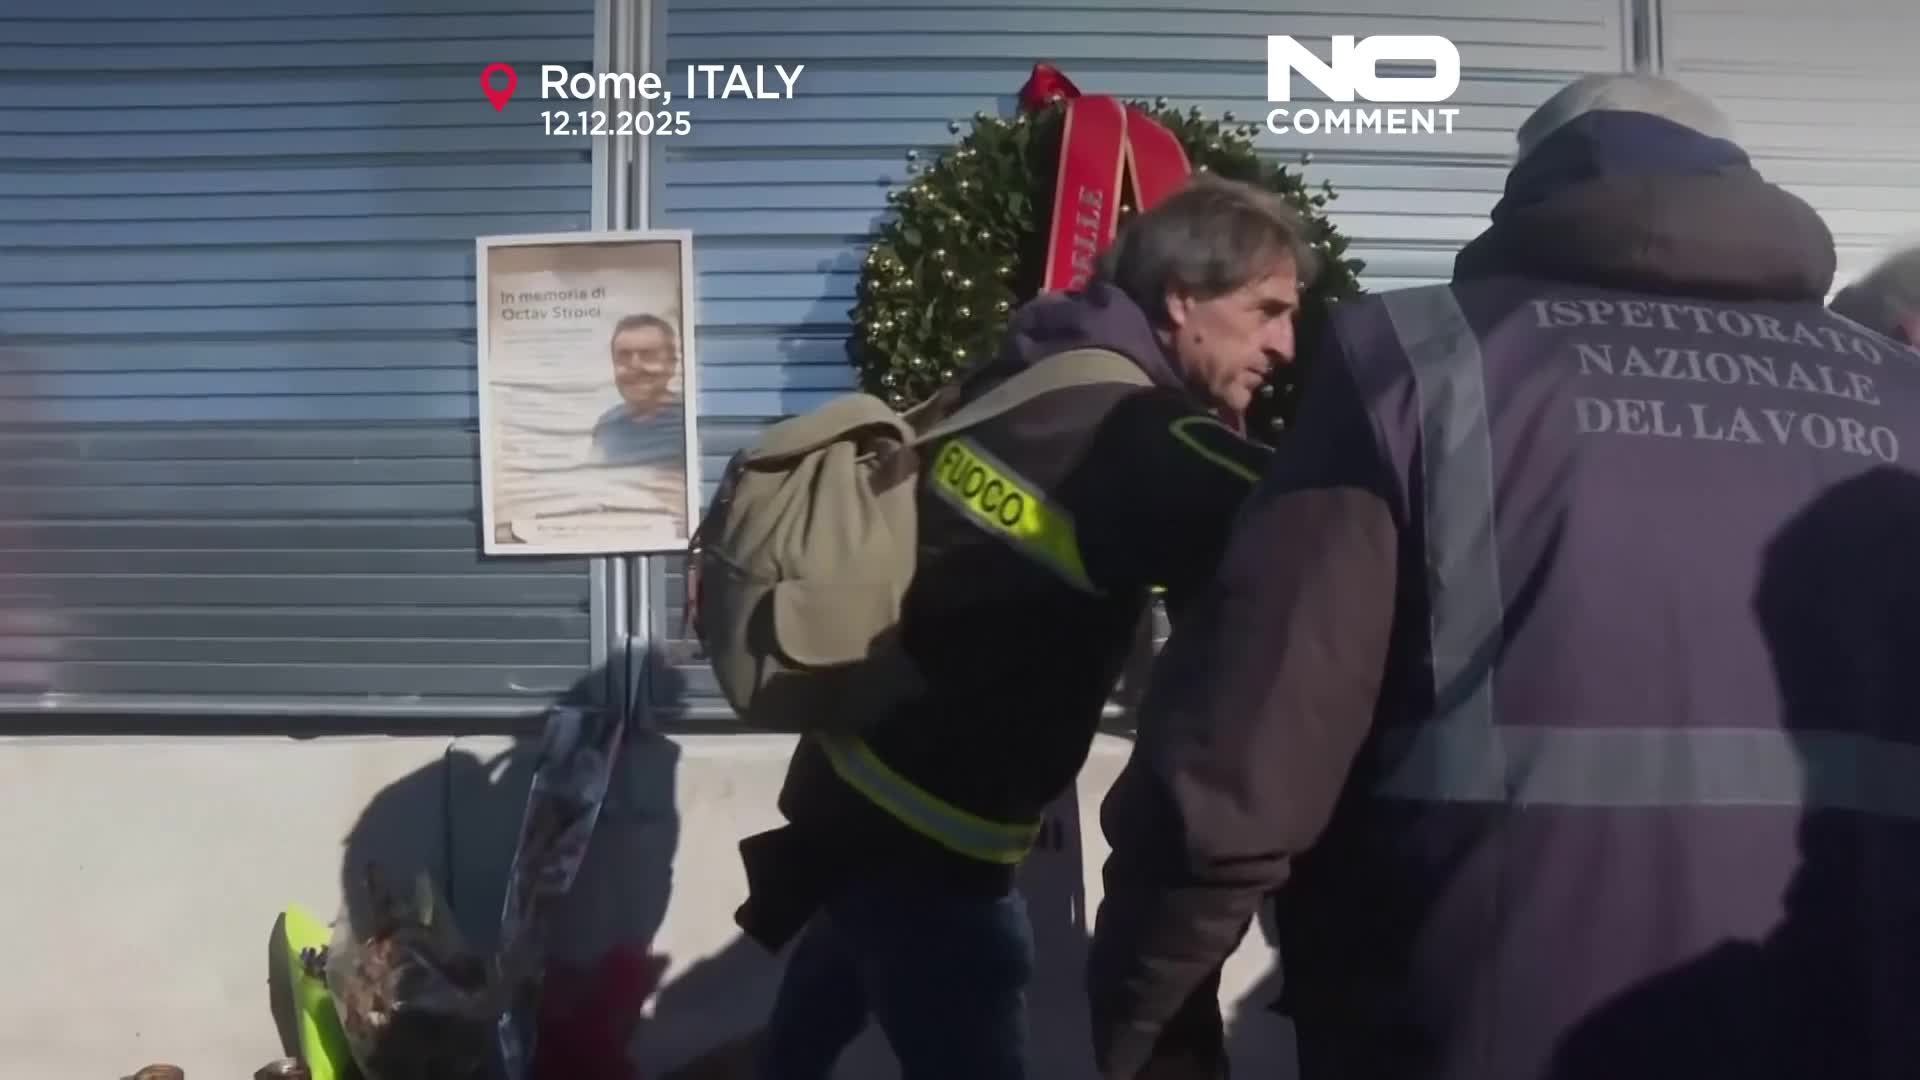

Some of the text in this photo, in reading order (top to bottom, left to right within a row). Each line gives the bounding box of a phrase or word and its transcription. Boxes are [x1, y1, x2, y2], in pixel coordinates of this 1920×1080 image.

[500, 286, 605, 304] In memoria di
[502, 306, 547, 321] Octav
[1534, 299, 1883, 365] ISPETTORATO
[1576, 343, 1881, 405] NAZIONALE
[1575, 398, 1900, 462] DEL LAVORO
[938, 445, 1024, 527] FUOCO
